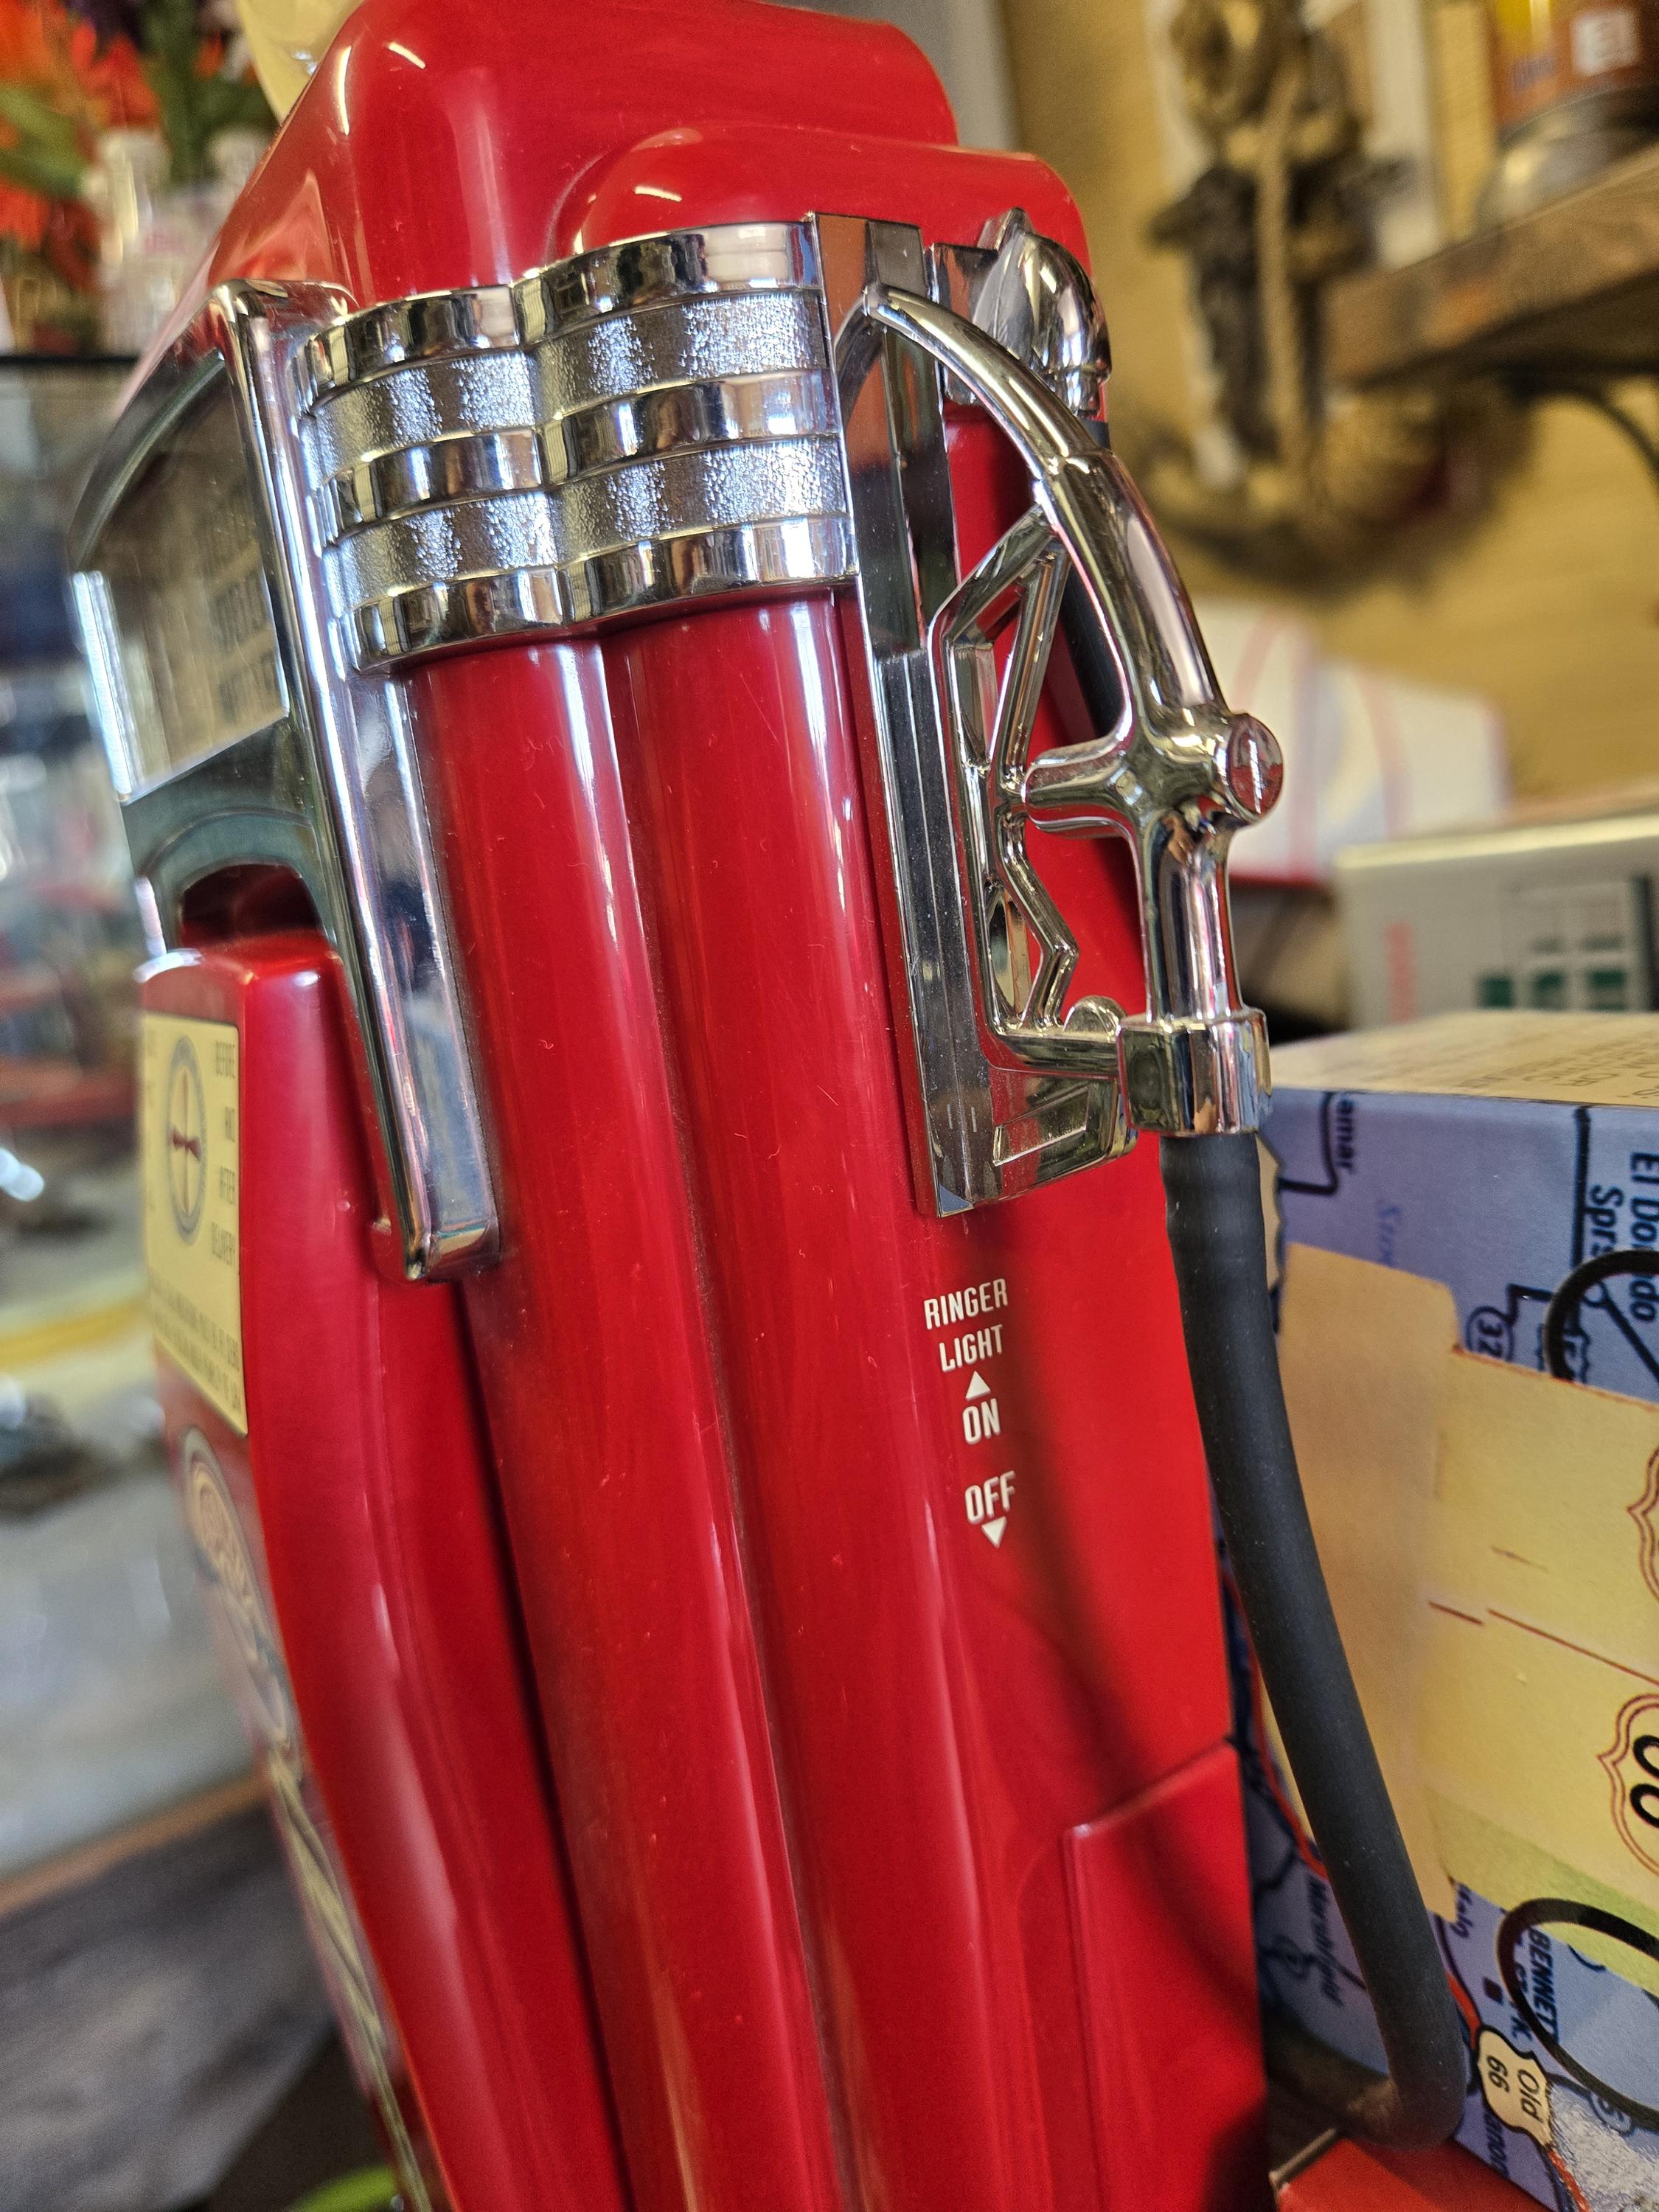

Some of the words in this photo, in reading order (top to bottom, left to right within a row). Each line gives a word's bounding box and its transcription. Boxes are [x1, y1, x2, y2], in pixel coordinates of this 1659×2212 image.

[1336, 1099, 1356, 1174] amar
[1630, 1197, 1659, 1322] Dodo
[924, 1278, 1008, 1330] RINGER
[939, 1324, 1003, 1373] LIGHT
[961, 1398, 1001, 1445] ON
[964, 1470, 1016, 1525] OFF
[1486, 2054, 1511, 2093] 66
[1517, 2067, 1544, 2125] Old
[1484, 2109, 1509, 2178] anon
